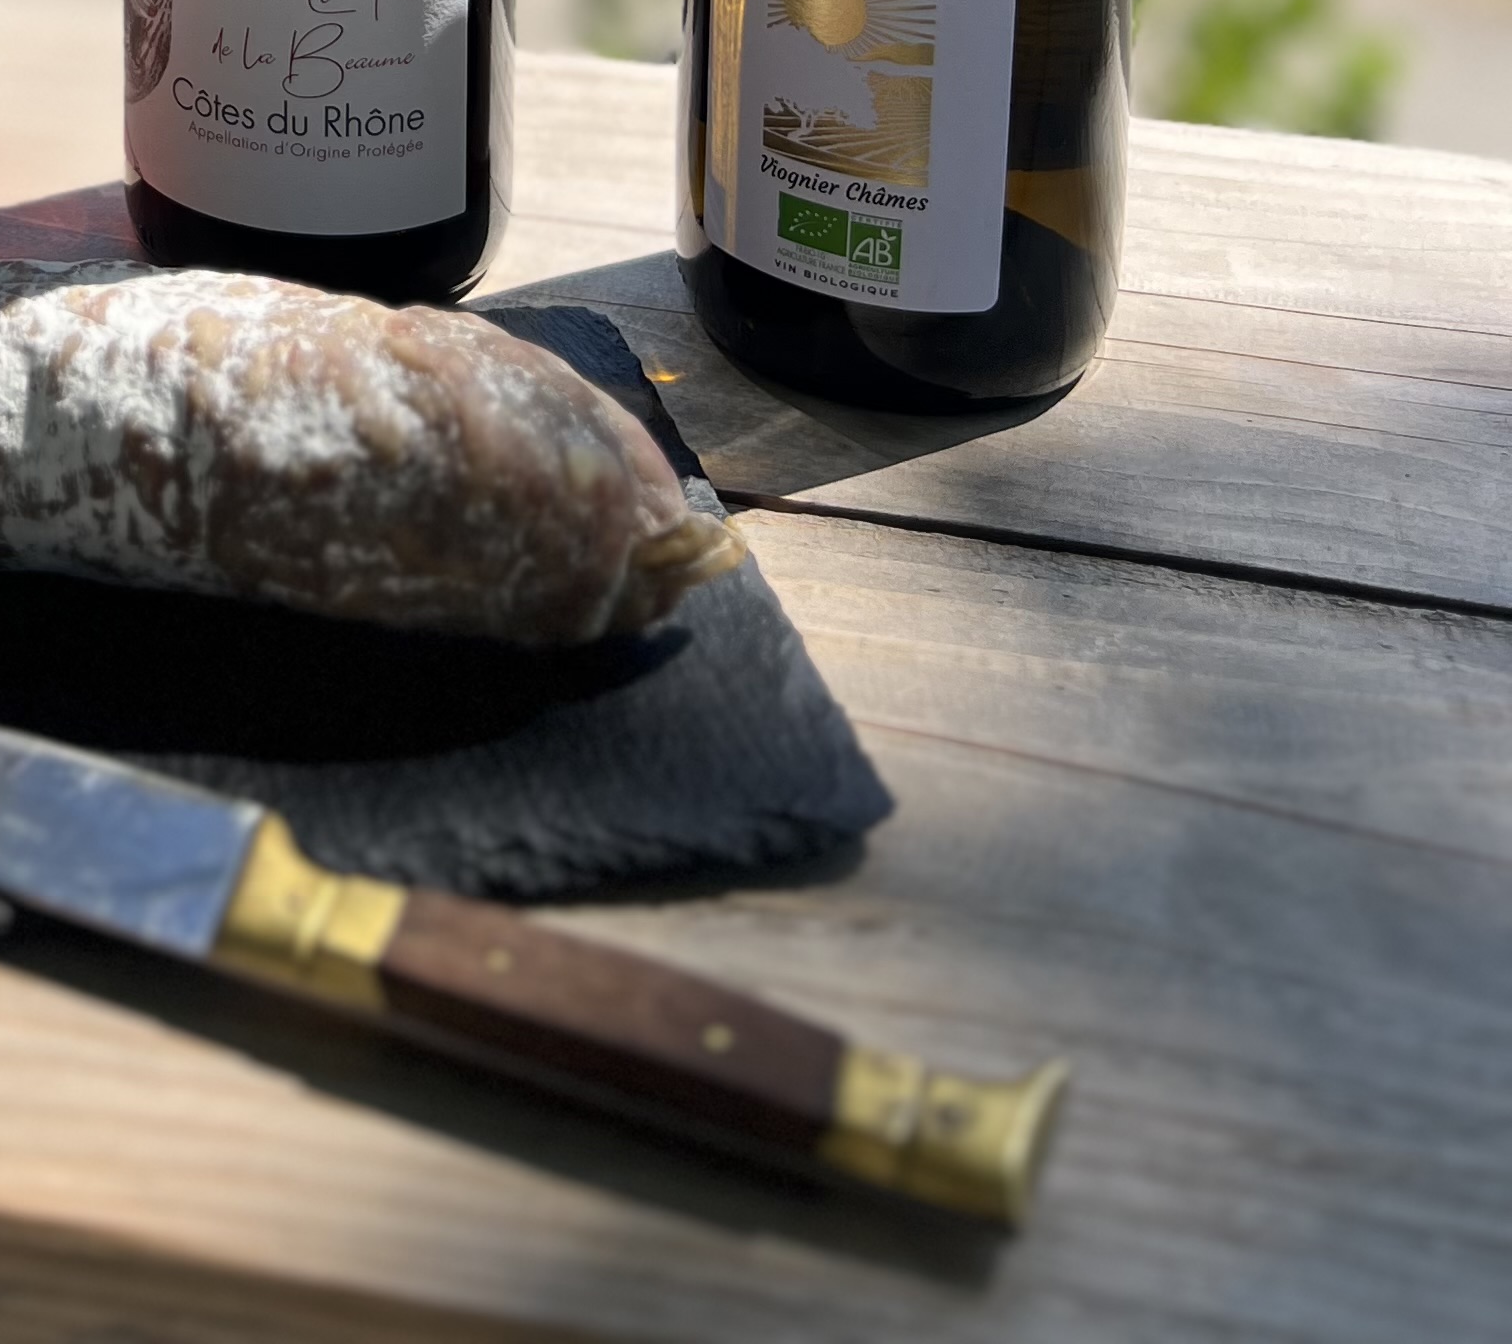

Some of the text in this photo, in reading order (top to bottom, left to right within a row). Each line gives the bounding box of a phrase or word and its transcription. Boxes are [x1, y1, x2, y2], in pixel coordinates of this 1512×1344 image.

[172, 77, 425, 138] Côtes du Rhône
[188, 120, 268, 153] Appellation
[357, 140, 424, 159] Protégée
[760, 154, 929, 211] Viognier Châmes
[852, 237, 893, 266] AB
[774, 259, 899, 298] VIN BIOLOGIQUE
